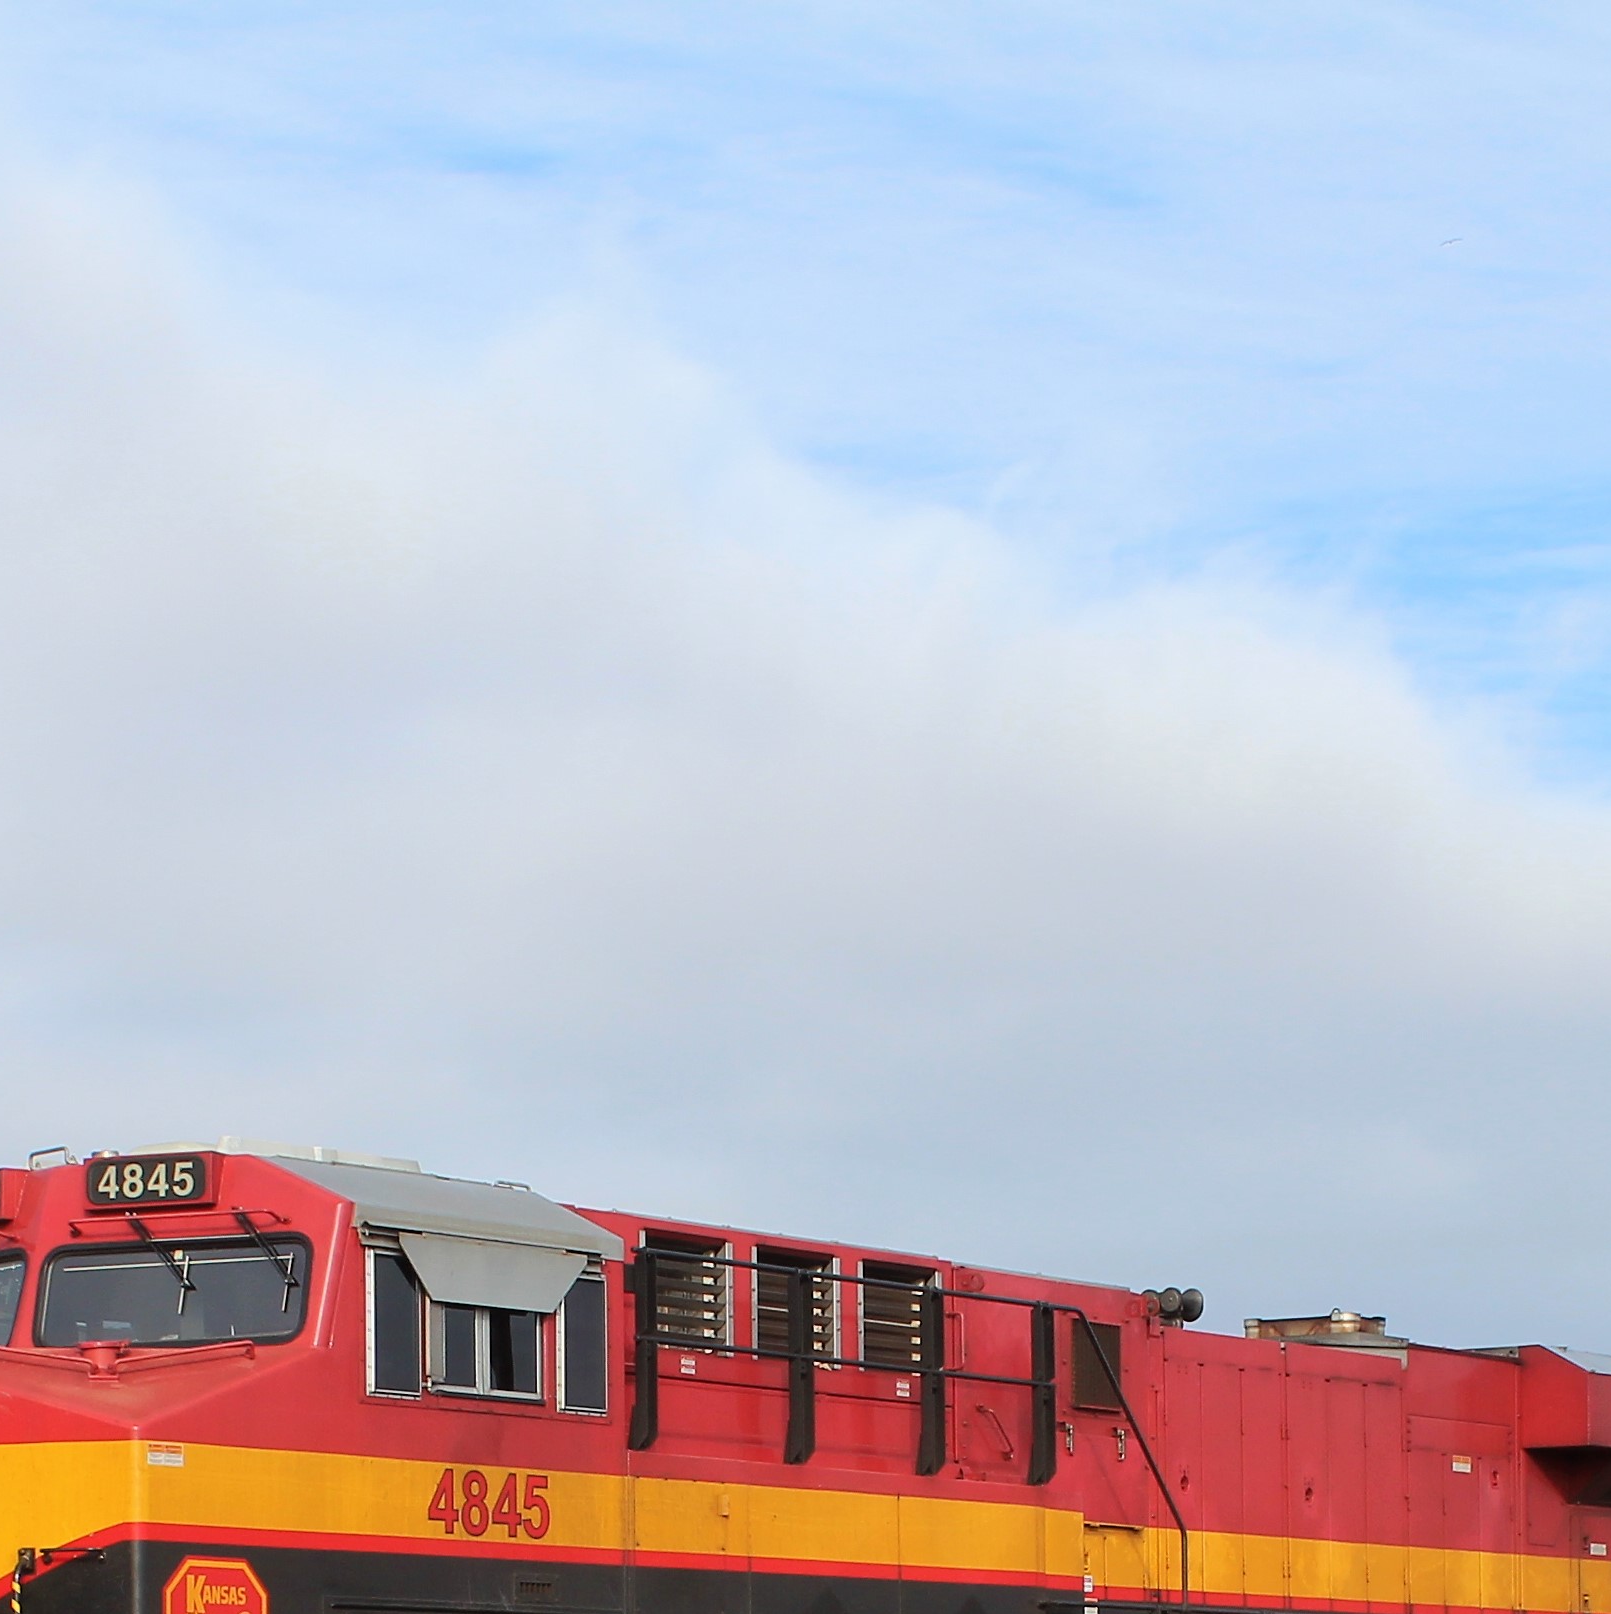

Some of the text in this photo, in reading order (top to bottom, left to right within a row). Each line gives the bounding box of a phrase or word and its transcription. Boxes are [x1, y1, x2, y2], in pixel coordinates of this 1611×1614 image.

[97, 1161, 195, 1200] 4845
[428, 1468, 550, 1539] 4845
[186, 1574, 247, 1613] KANSAS
